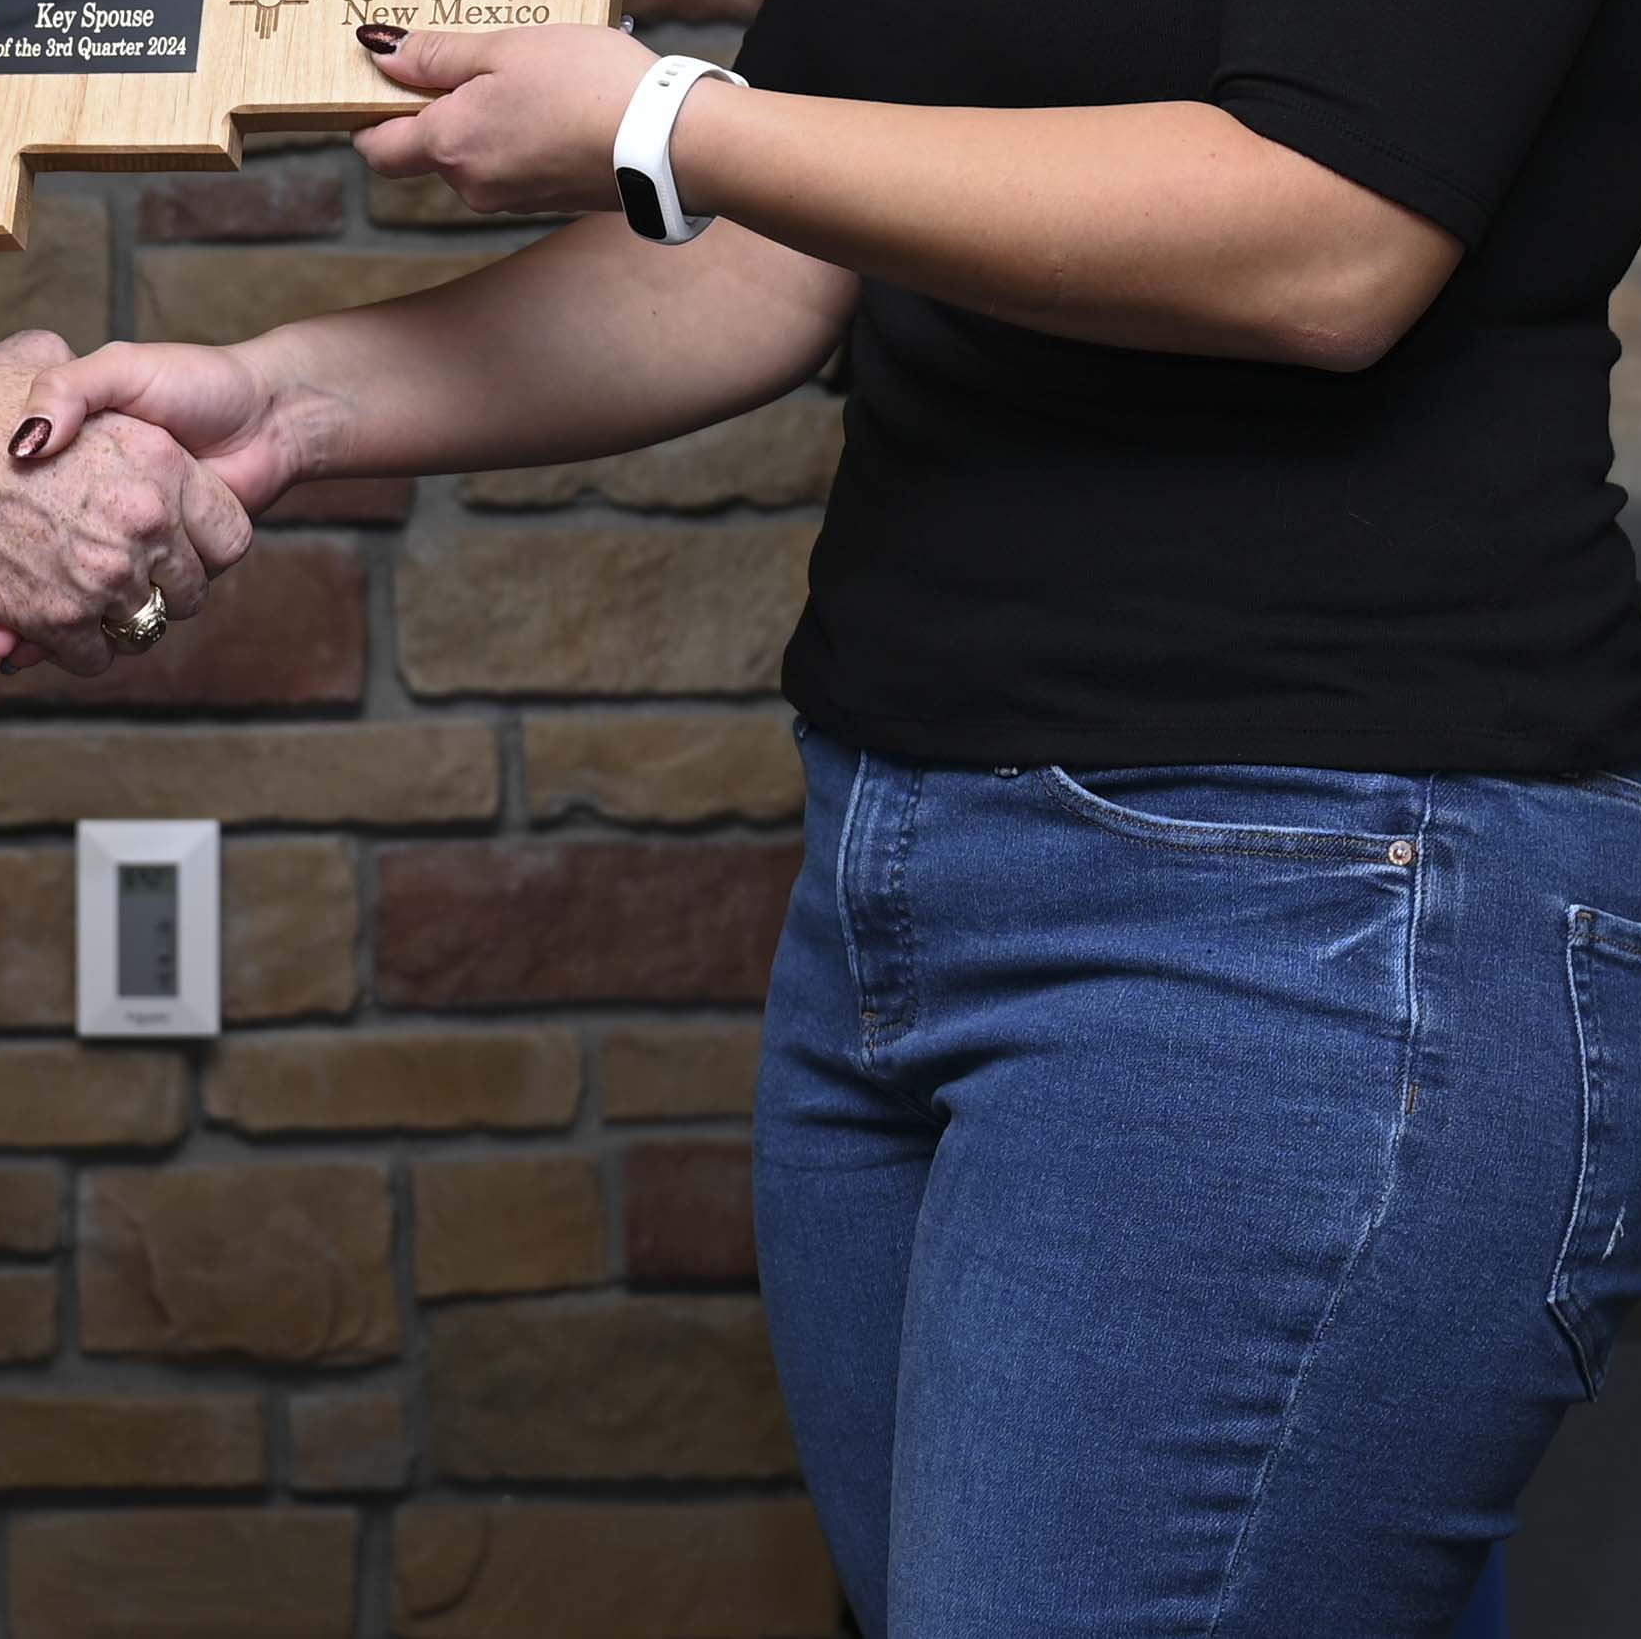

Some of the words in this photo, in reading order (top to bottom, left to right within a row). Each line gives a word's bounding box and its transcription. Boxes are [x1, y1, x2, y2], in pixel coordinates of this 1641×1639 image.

[34, 2, 77, 33] Key
[81, 2, 155, 33] Spouse
[15, 37, 41, 57] the
[45, 37, 73, 57] 3rd
[77, 36, 144, 60] Quarter
[146, 36, 187, 56] 2024
